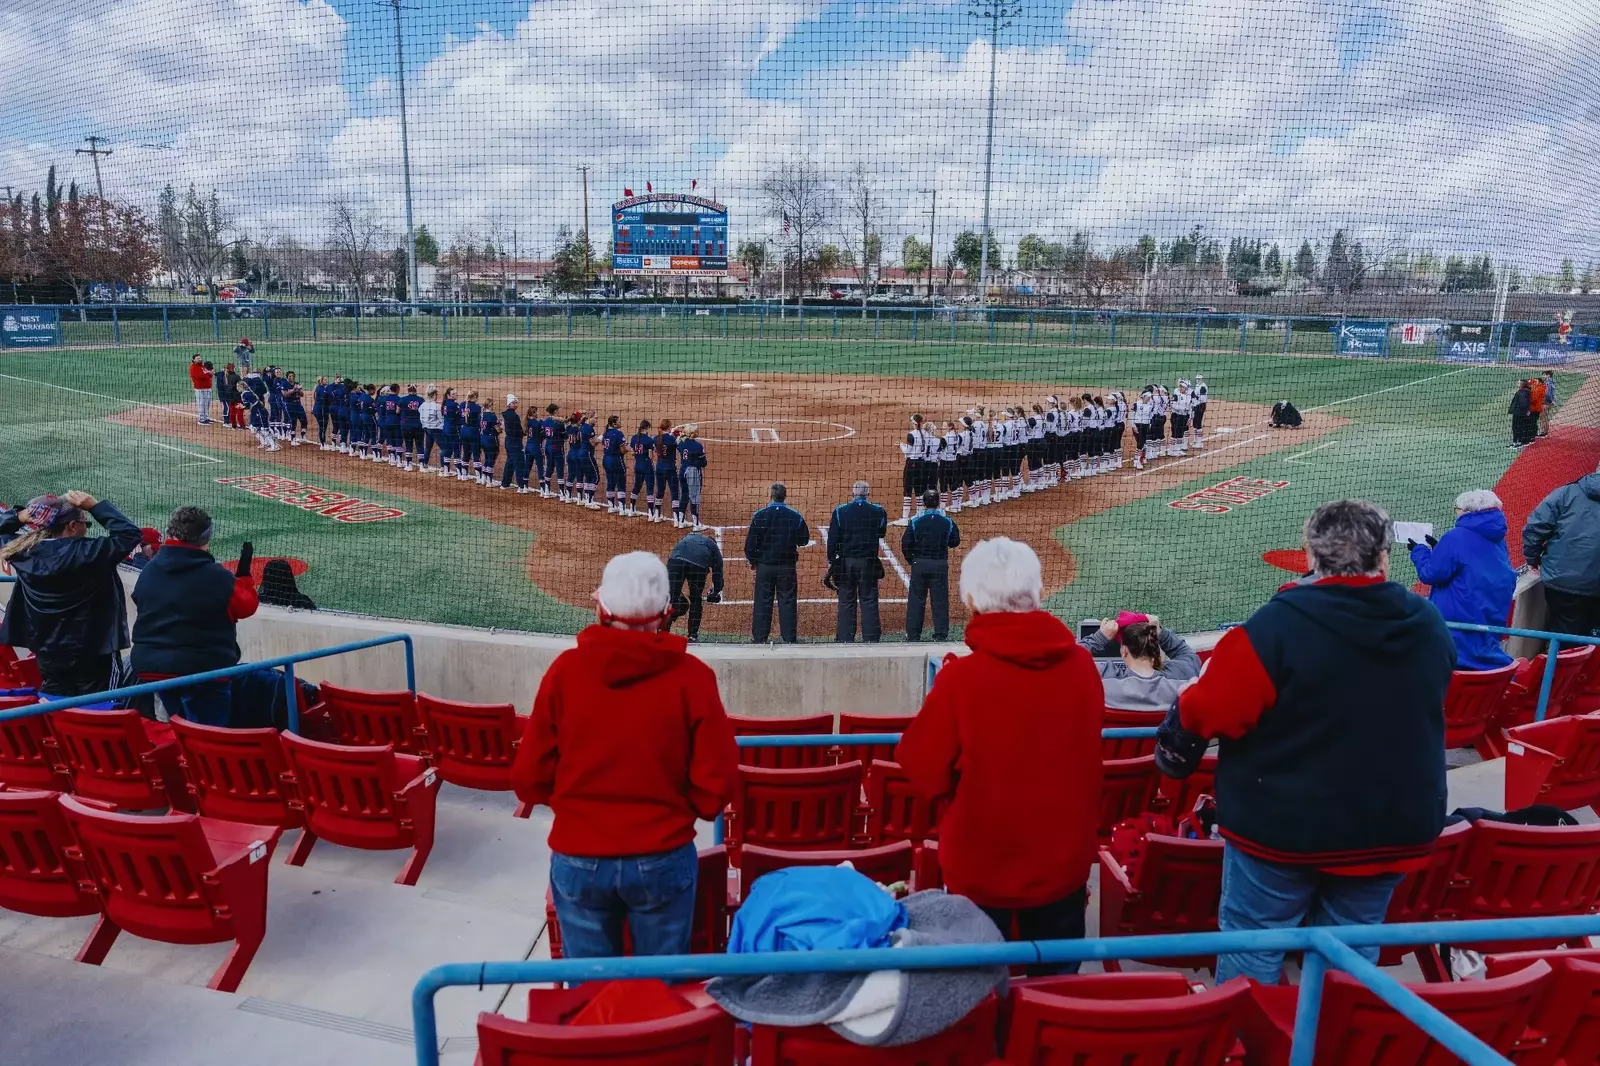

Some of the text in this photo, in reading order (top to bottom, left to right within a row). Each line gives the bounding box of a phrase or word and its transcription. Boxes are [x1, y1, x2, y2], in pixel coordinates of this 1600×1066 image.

[1451, 341, 1486, 352] AXIS
[215, 473, 407, 523] FRESNO
[1167, 475, 1290, 514] STATE
